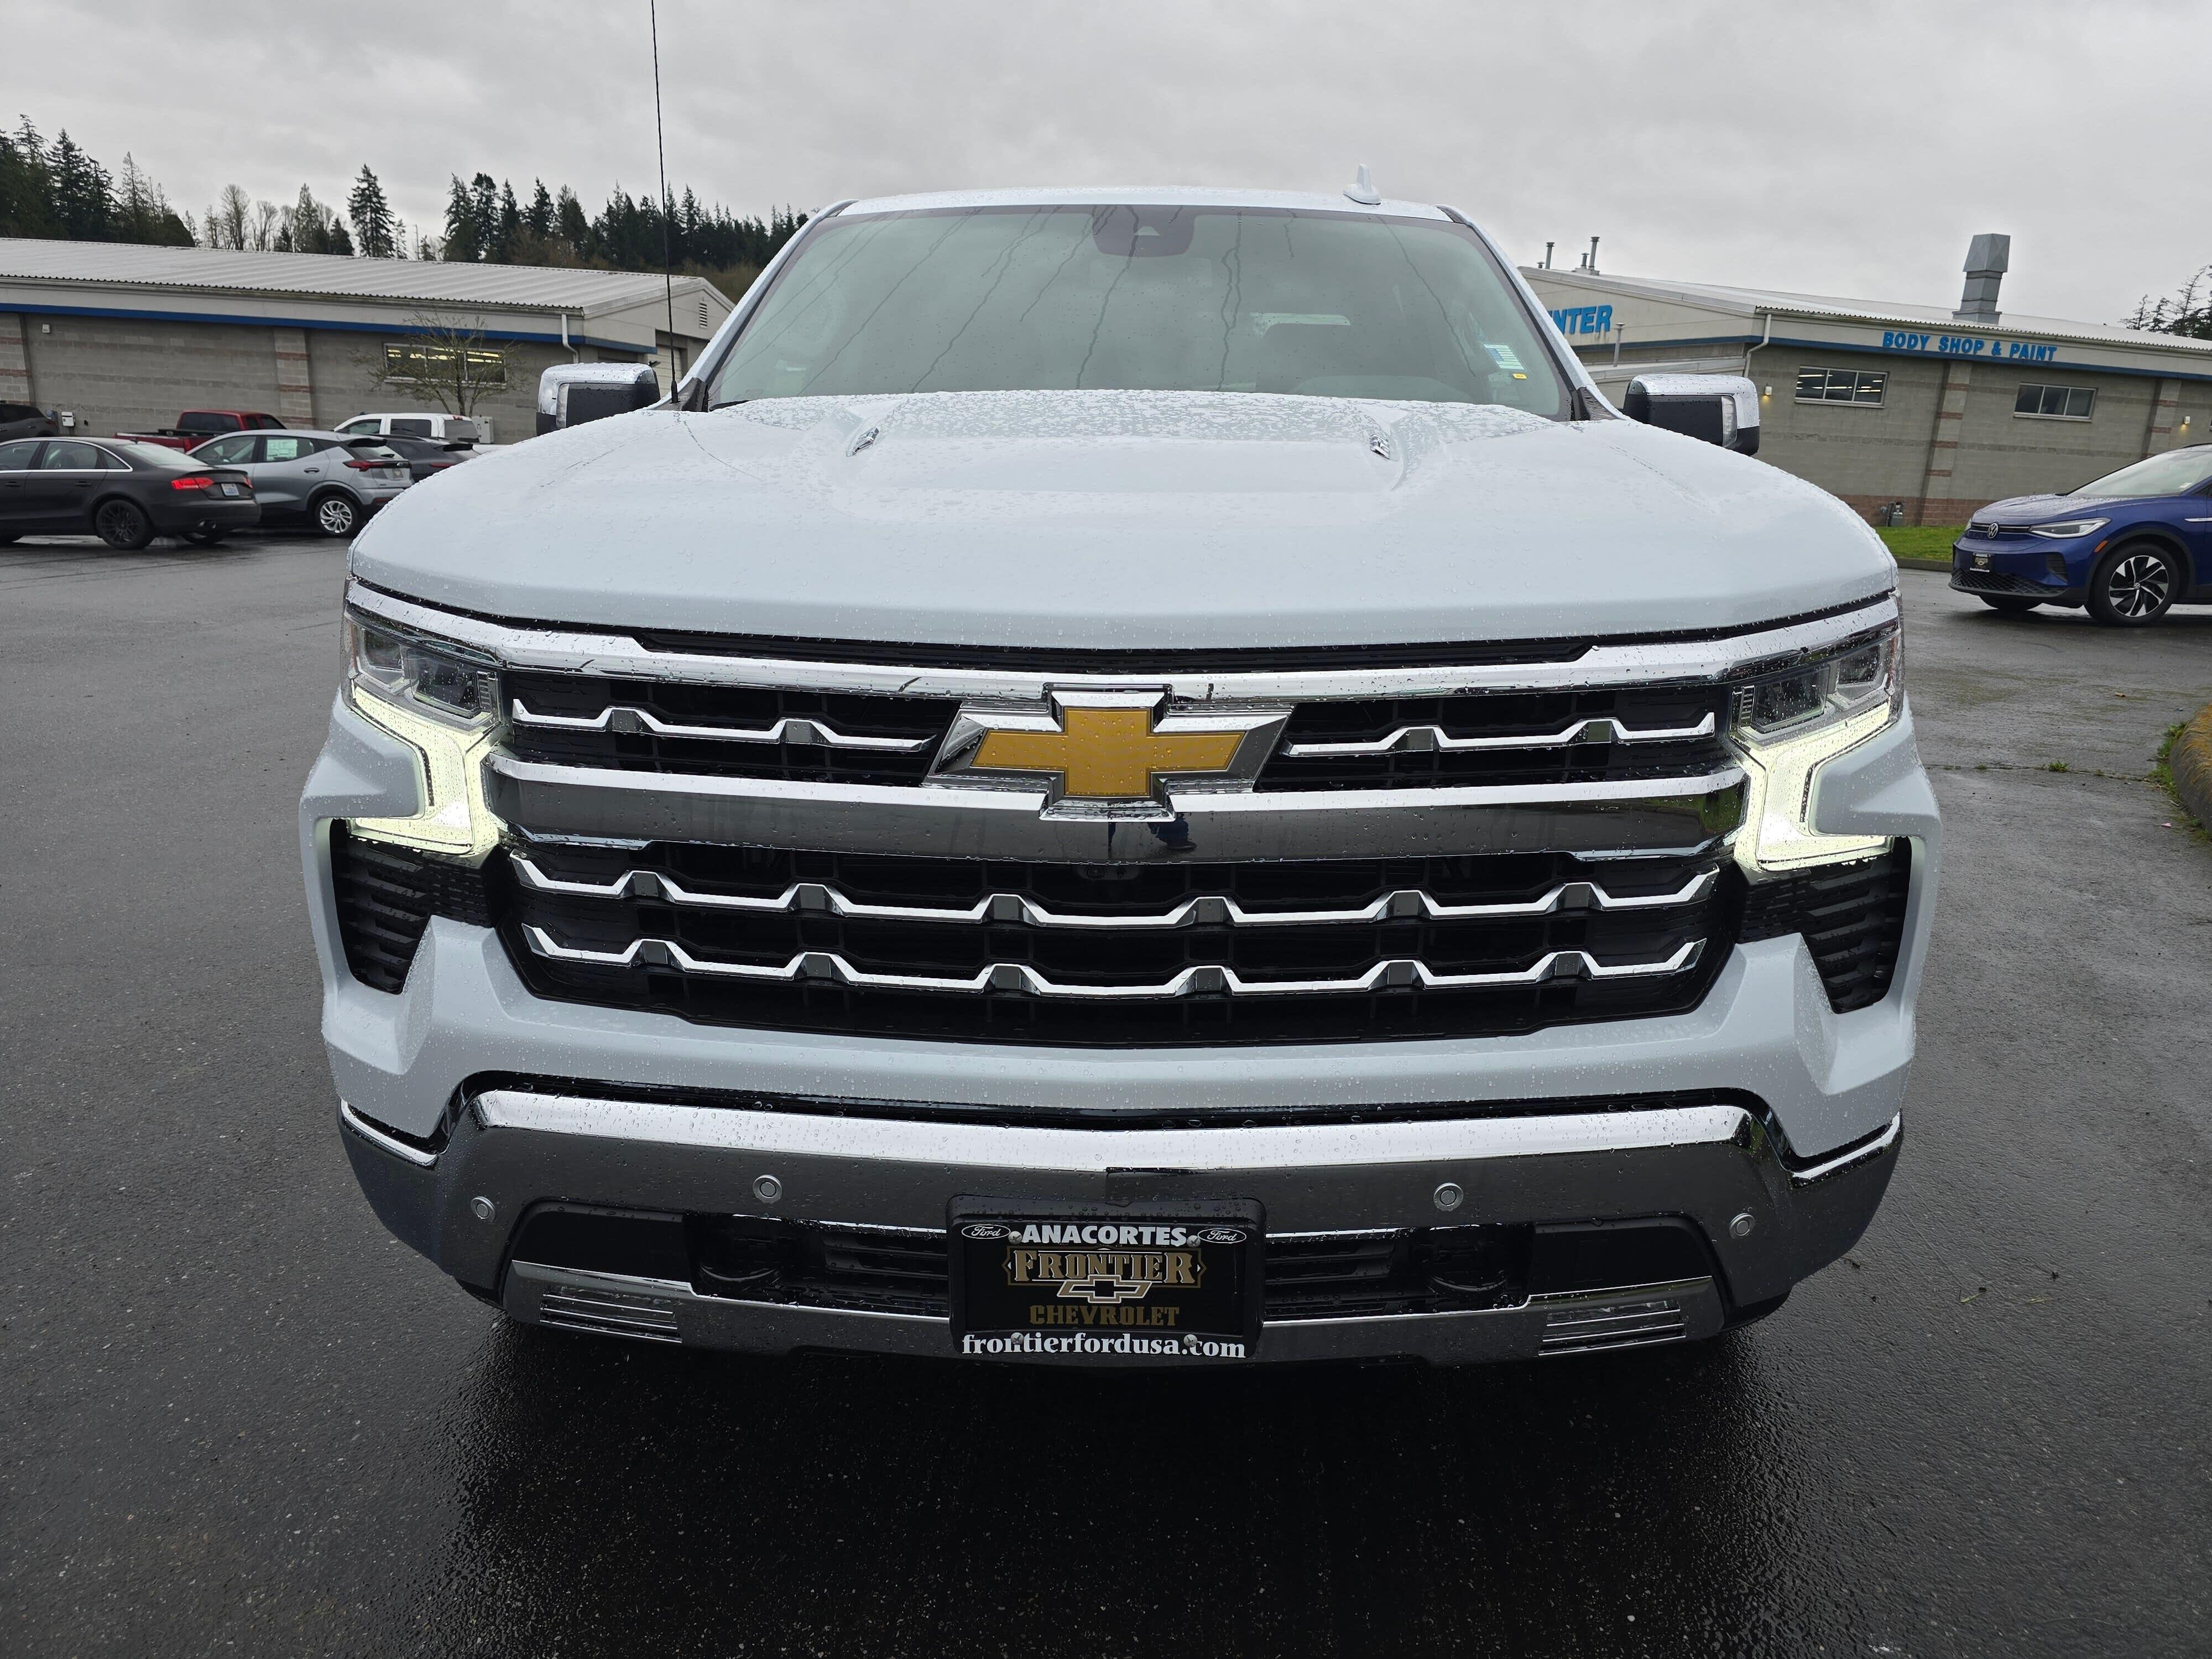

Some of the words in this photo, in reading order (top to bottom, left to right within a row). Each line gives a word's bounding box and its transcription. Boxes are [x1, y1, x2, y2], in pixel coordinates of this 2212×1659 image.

[1548, 305, 1613, 335] NTER
[1882, 331, 1931, 350] BODY
[1938, 336, 1984, 354] SHOP
[1991, 341, 2002, 356] &
[2009, 343, 2058, 361] PAINT
[971, 1225, 1002, 1237] Ford
[1021, 1224, 1187, 1245] ANACORTES
[1207, 1230, 1238, 1241] Ford
[1013, 1249, 1196, 1284] FRONTIER
[1029, 1305, 1180, 1326] CHEVROLET
[962, 1332, 1246, 1358] frontierfordusa.com
